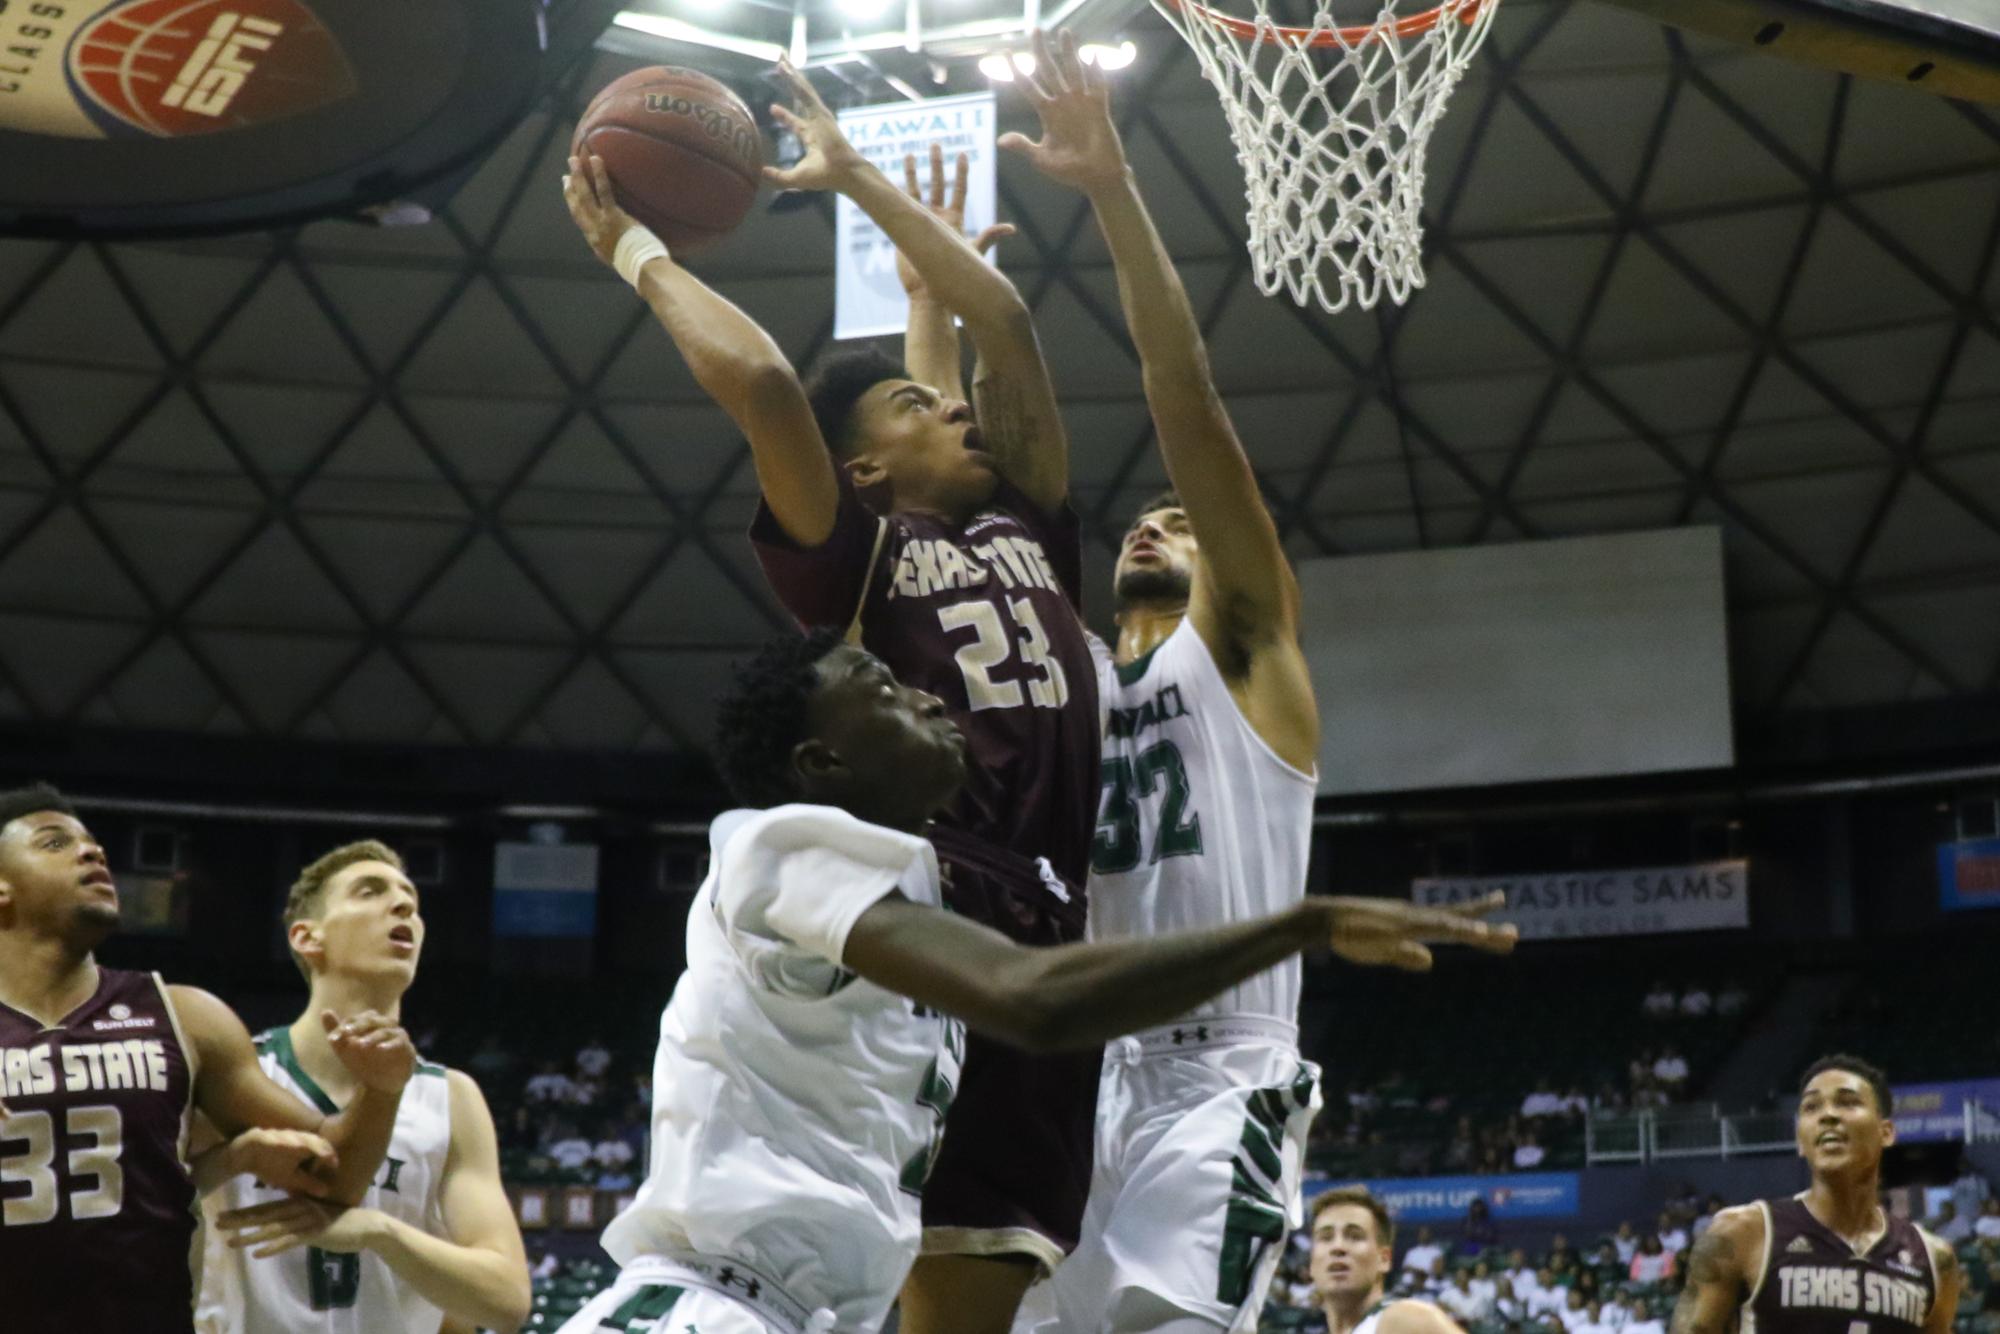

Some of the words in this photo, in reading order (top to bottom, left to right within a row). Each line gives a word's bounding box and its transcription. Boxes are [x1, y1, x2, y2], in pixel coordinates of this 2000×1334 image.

[160, 12, 284, 117] ESPN
[849, 108, 983, 143] HAWAII
[936, 594, 1069, 712] 23
[1091, 739, 1204, 876] 32
[1632, 871, 1735, 904] SAMS
[61, 1039, 168, 1092] STATE
[0, 1105, 124, 1226] 33
[1778, 1265, 1859, 1310] TEXAS
[1863, 1271, 1928, 1328] STATE
